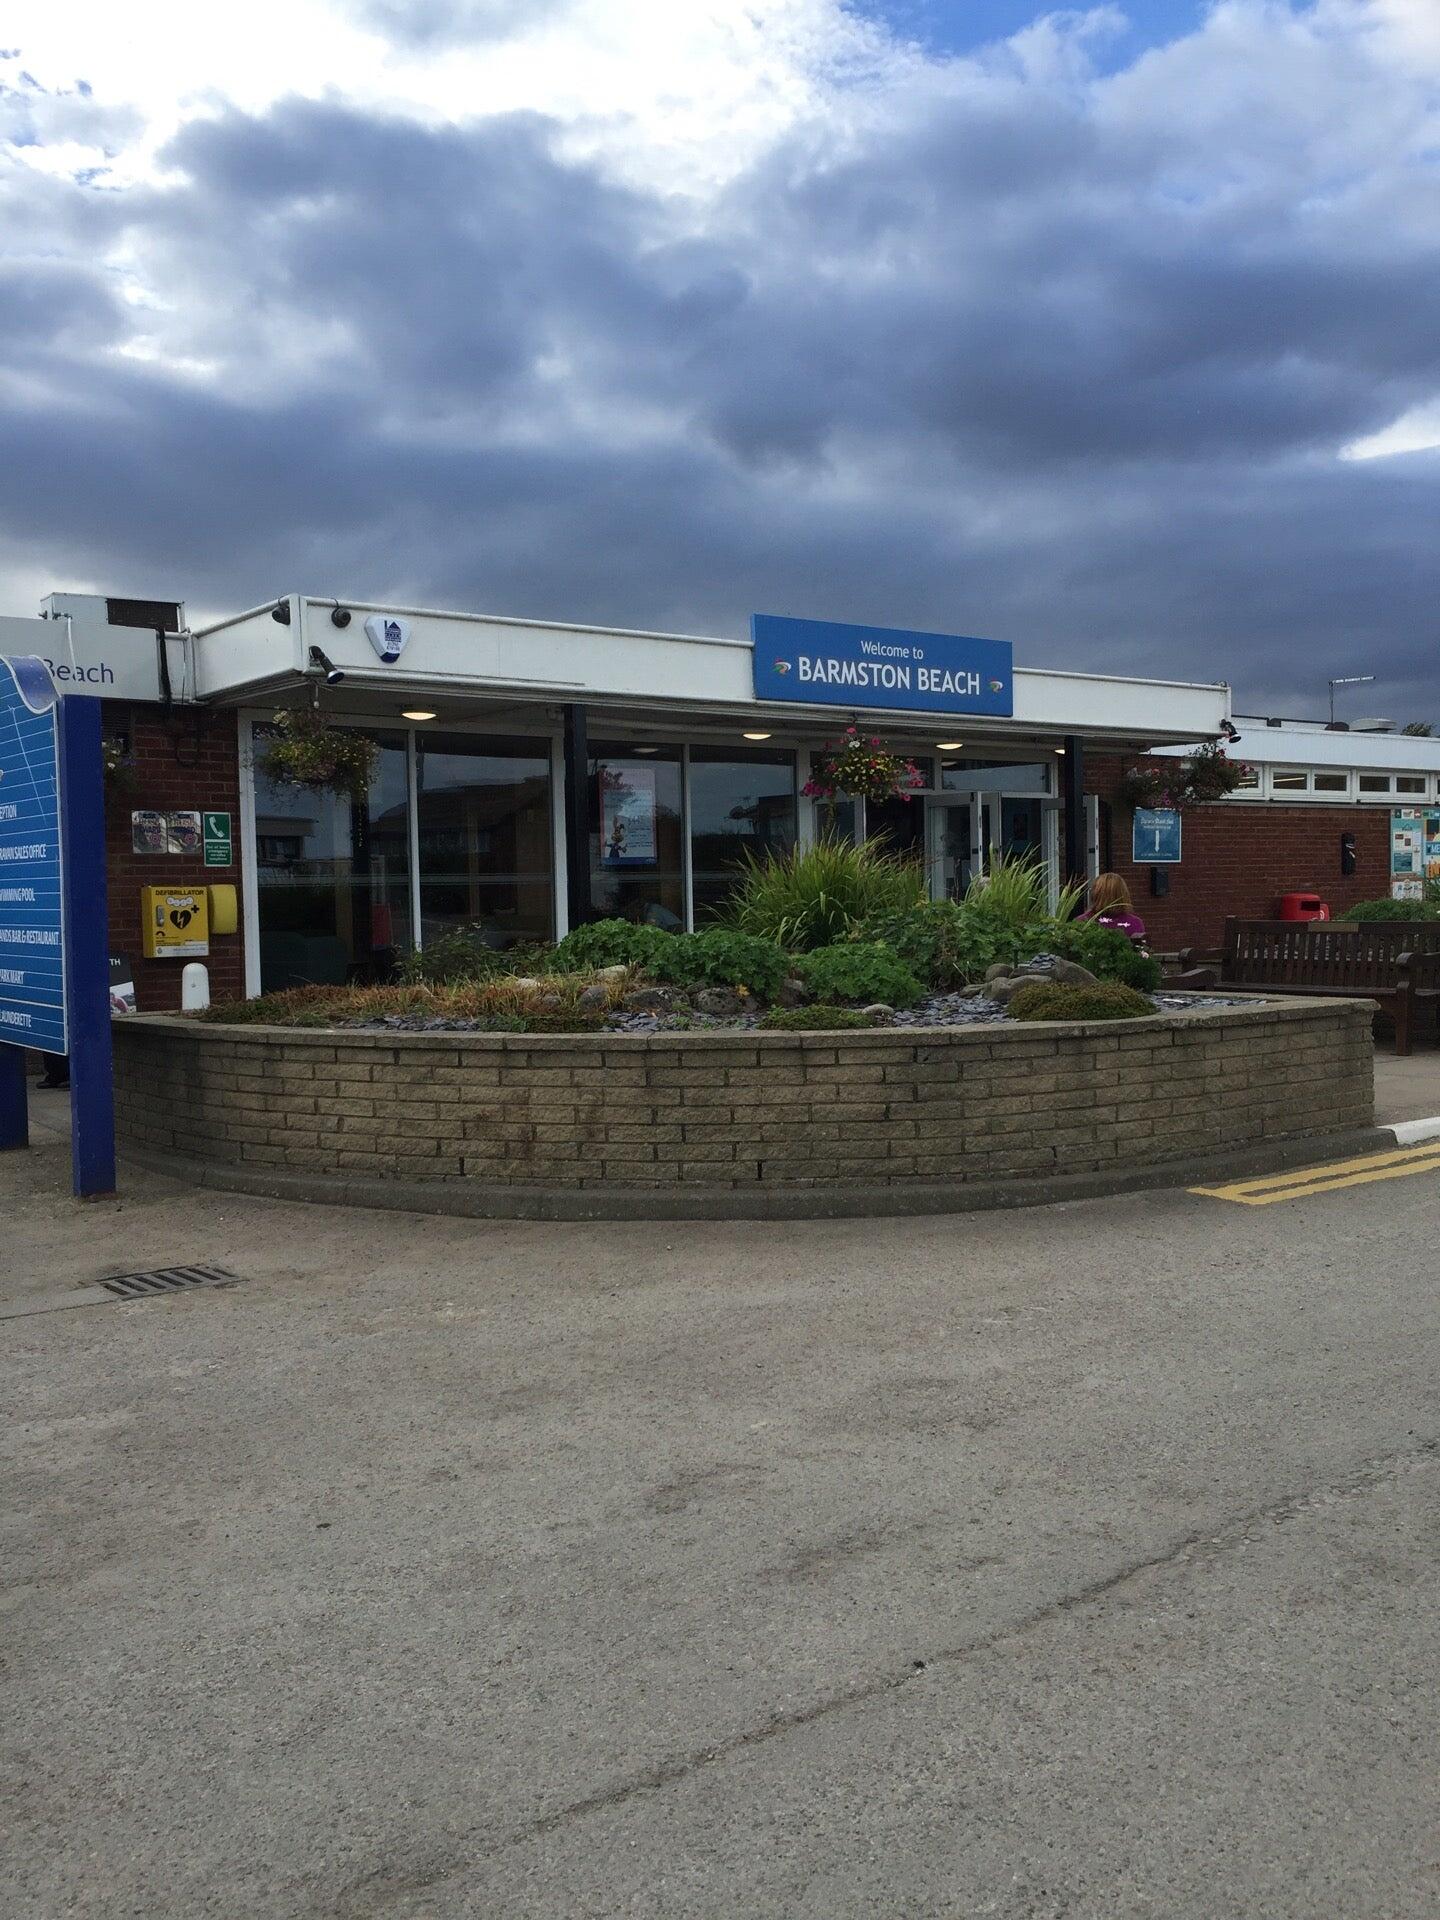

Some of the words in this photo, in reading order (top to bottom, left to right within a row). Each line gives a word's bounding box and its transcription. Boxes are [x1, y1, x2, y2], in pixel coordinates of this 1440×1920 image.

[861, 640, 909, 659] Welcome
[912, 646, 924, 660] to
[798, 656, 911, 690] BARMSTON
[917, 668, 980, 695] BEACH
[14, 845, 29, 860] SALES
[29, 843, 47, 859] OFFICE
[22, 887, 35, 901] POOL
[27, 930, 60, 946] RESTAURANT
